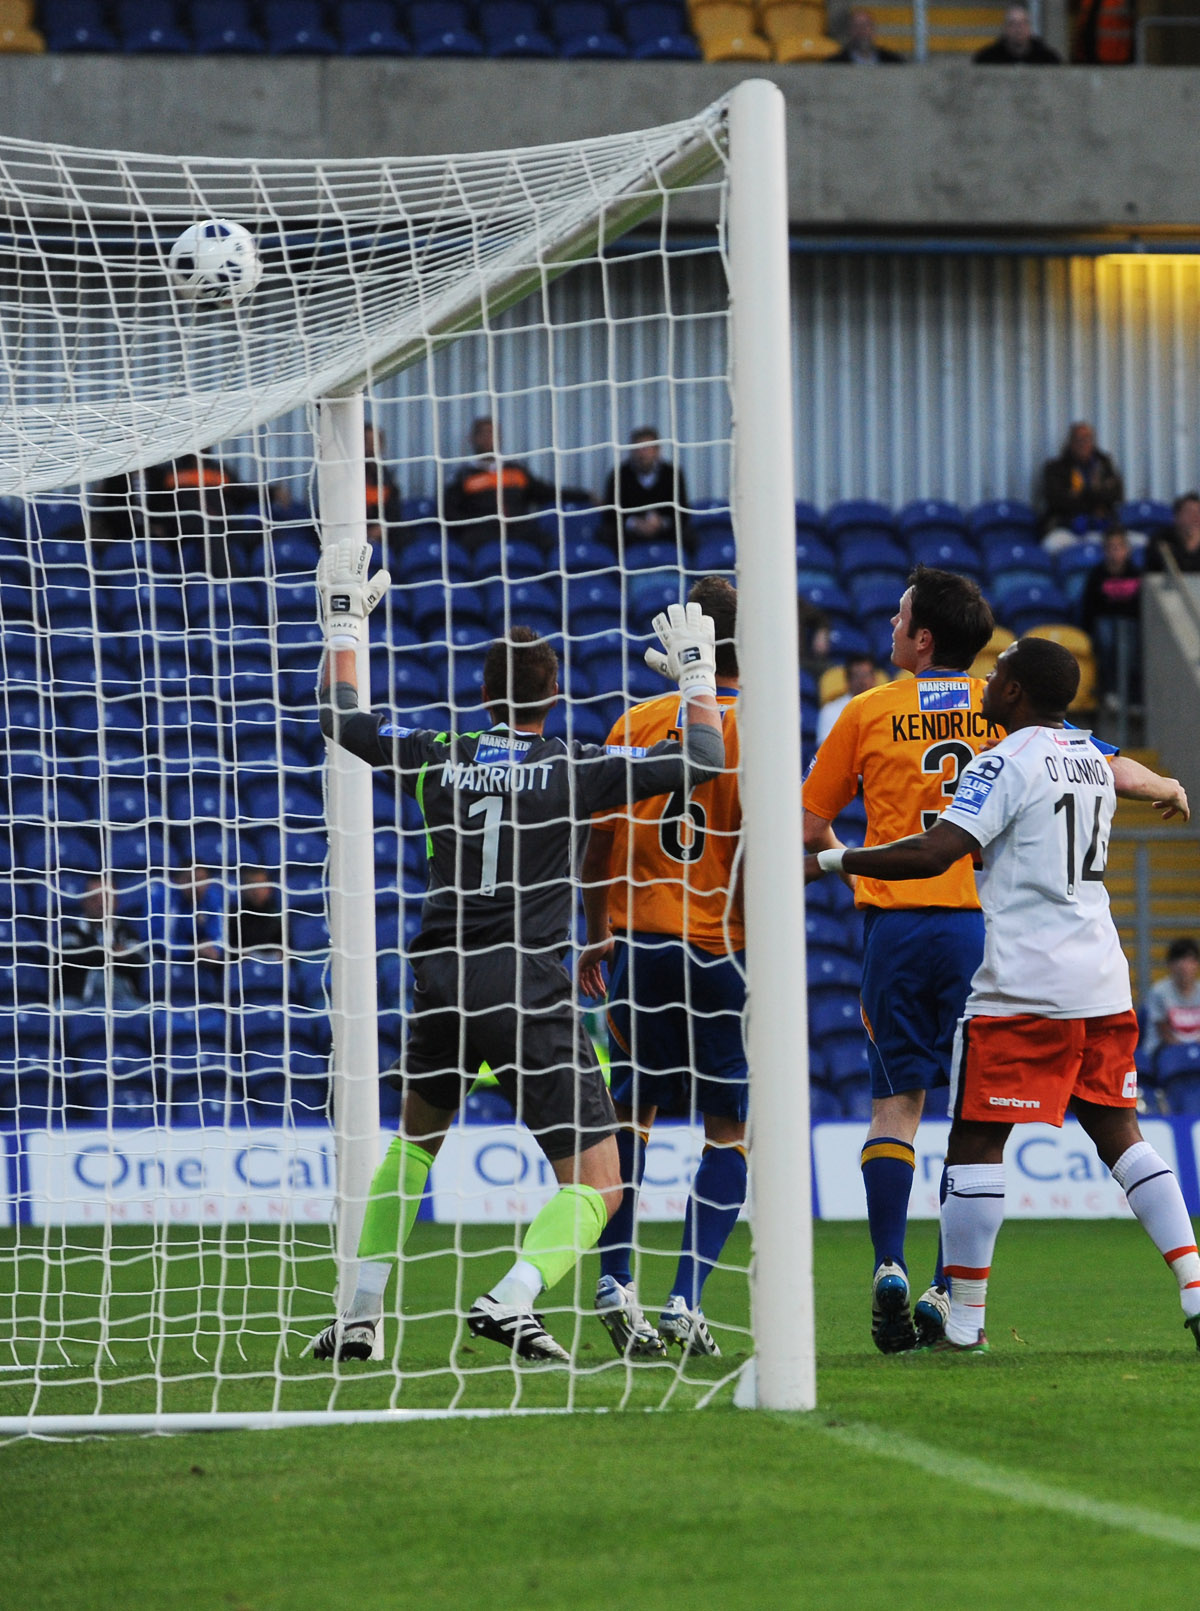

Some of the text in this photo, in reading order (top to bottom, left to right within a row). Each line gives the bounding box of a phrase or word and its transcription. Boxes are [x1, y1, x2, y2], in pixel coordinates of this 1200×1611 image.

[919, 681, 968, 692] MANSFIELD
[441, 759, 553, 793] MARRIOTT
[921, 740, 977, 832] 3
[468, 796, 503, 897] 1
[659, 786, 707, 864] 6
[1054, 793, 1108, 896] 14
[73, 1143, 330, 1190] One Cal
[1016, 1136, 1111, 1182] Ca
[82, 1200, 328, 1220] INSURANC
